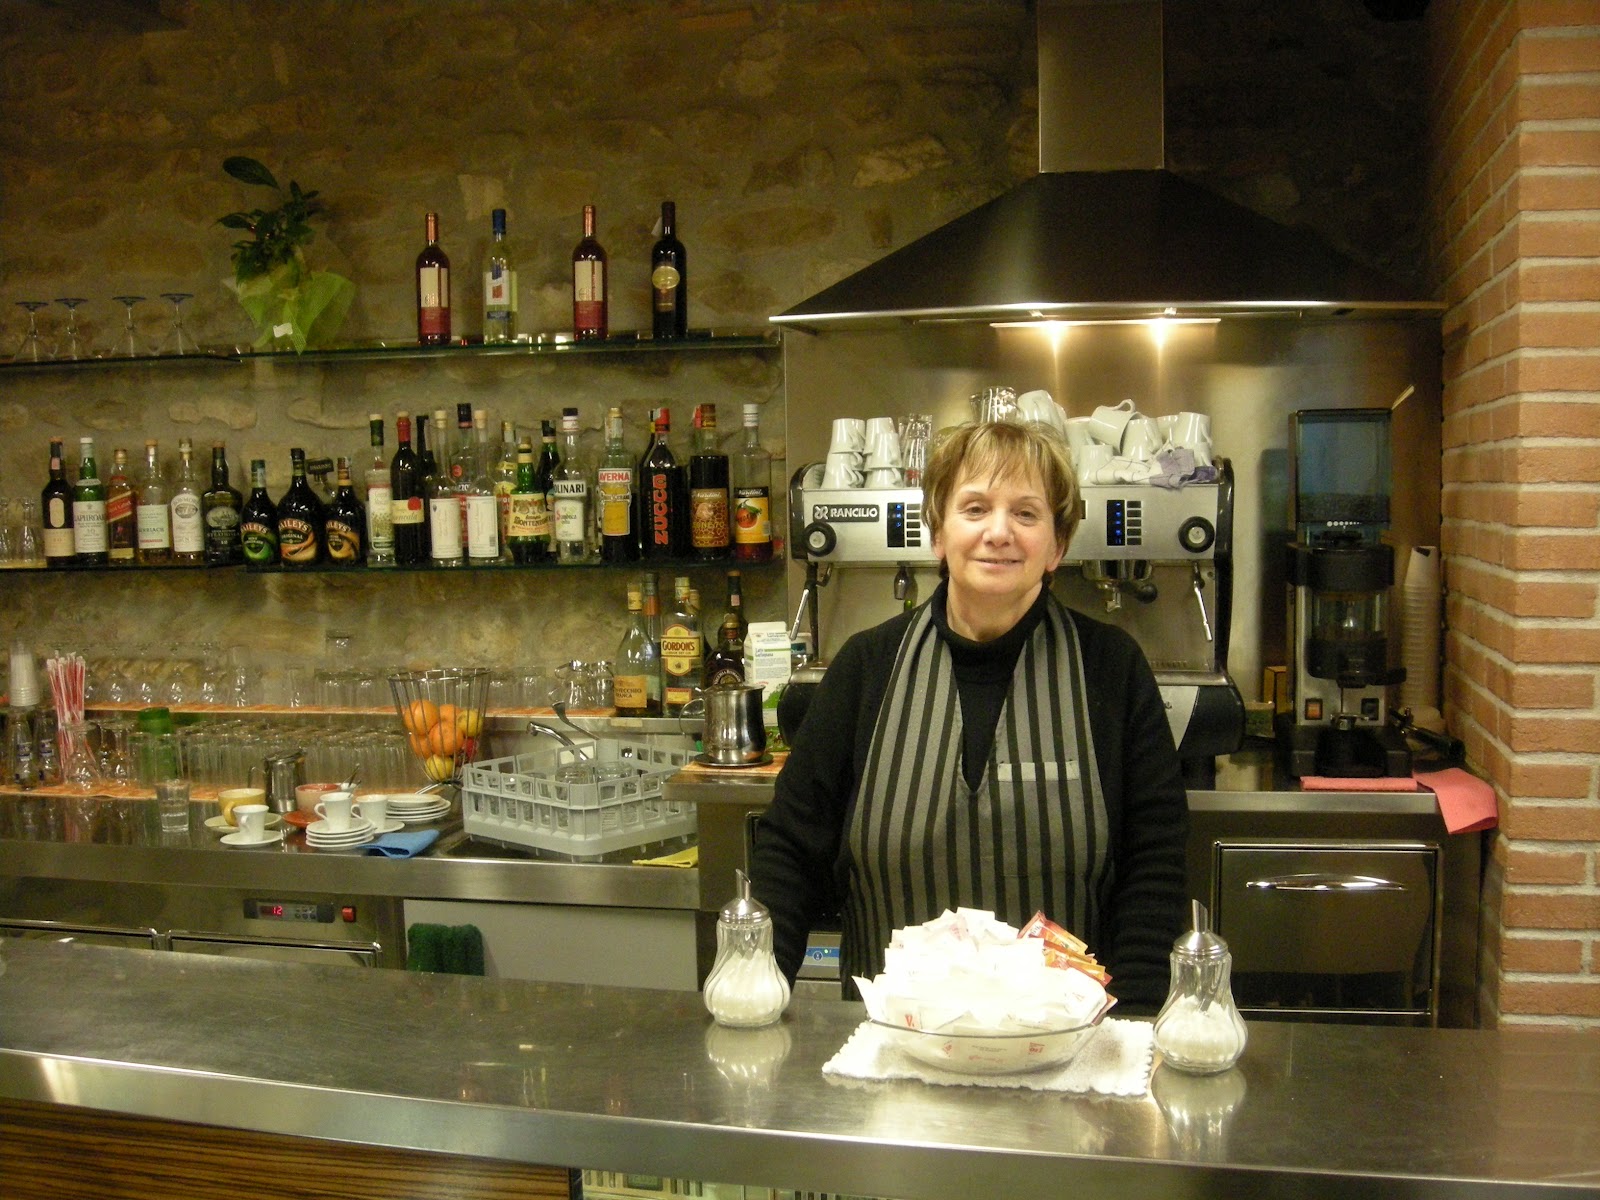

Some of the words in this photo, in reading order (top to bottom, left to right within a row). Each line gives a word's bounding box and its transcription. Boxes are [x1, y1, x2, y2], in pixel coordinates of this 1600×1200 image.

[599, 473, 630, 481] AVERNA
[554, 483, 584, 495] OLINARI
[830, 507, 878, 518] RANCILIO
[241, 524, 267, 534] AILEYS
[279, 520, 310, 533] AILEYS
[662, 640, 695, 651] GORDON'S
